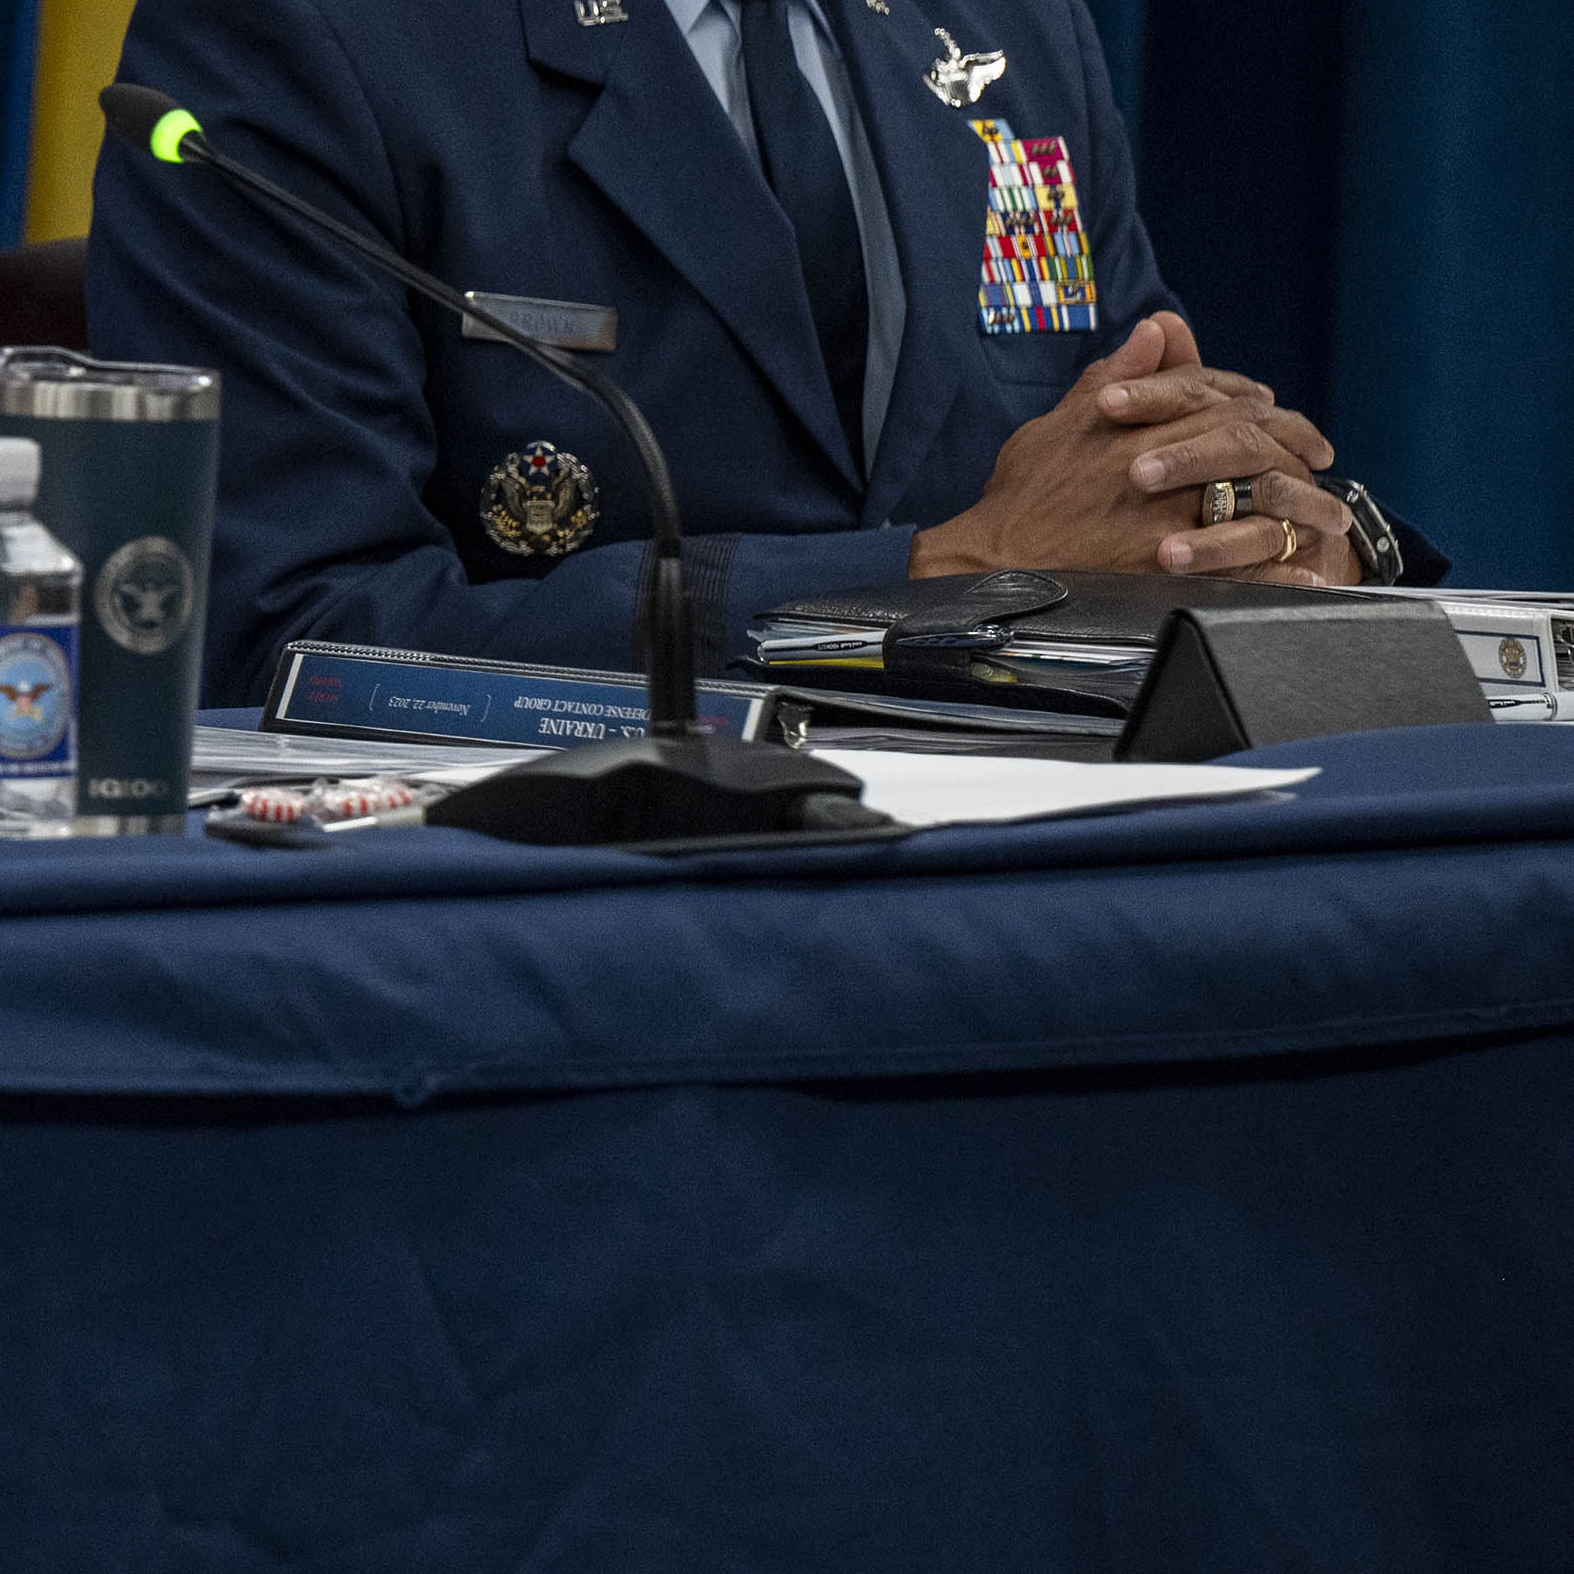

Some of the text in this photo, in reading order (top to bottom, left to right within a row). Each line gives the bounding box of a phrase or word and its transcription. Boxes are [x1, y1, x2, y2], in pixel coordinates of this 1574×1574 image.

[388, 695, 411, 709] 2023
[425, 699, 471, 716] November
[514, 696, 651, 721] DEFENSE CONTACT GROUP
[538, 717, 605, 740] UKRAINE
